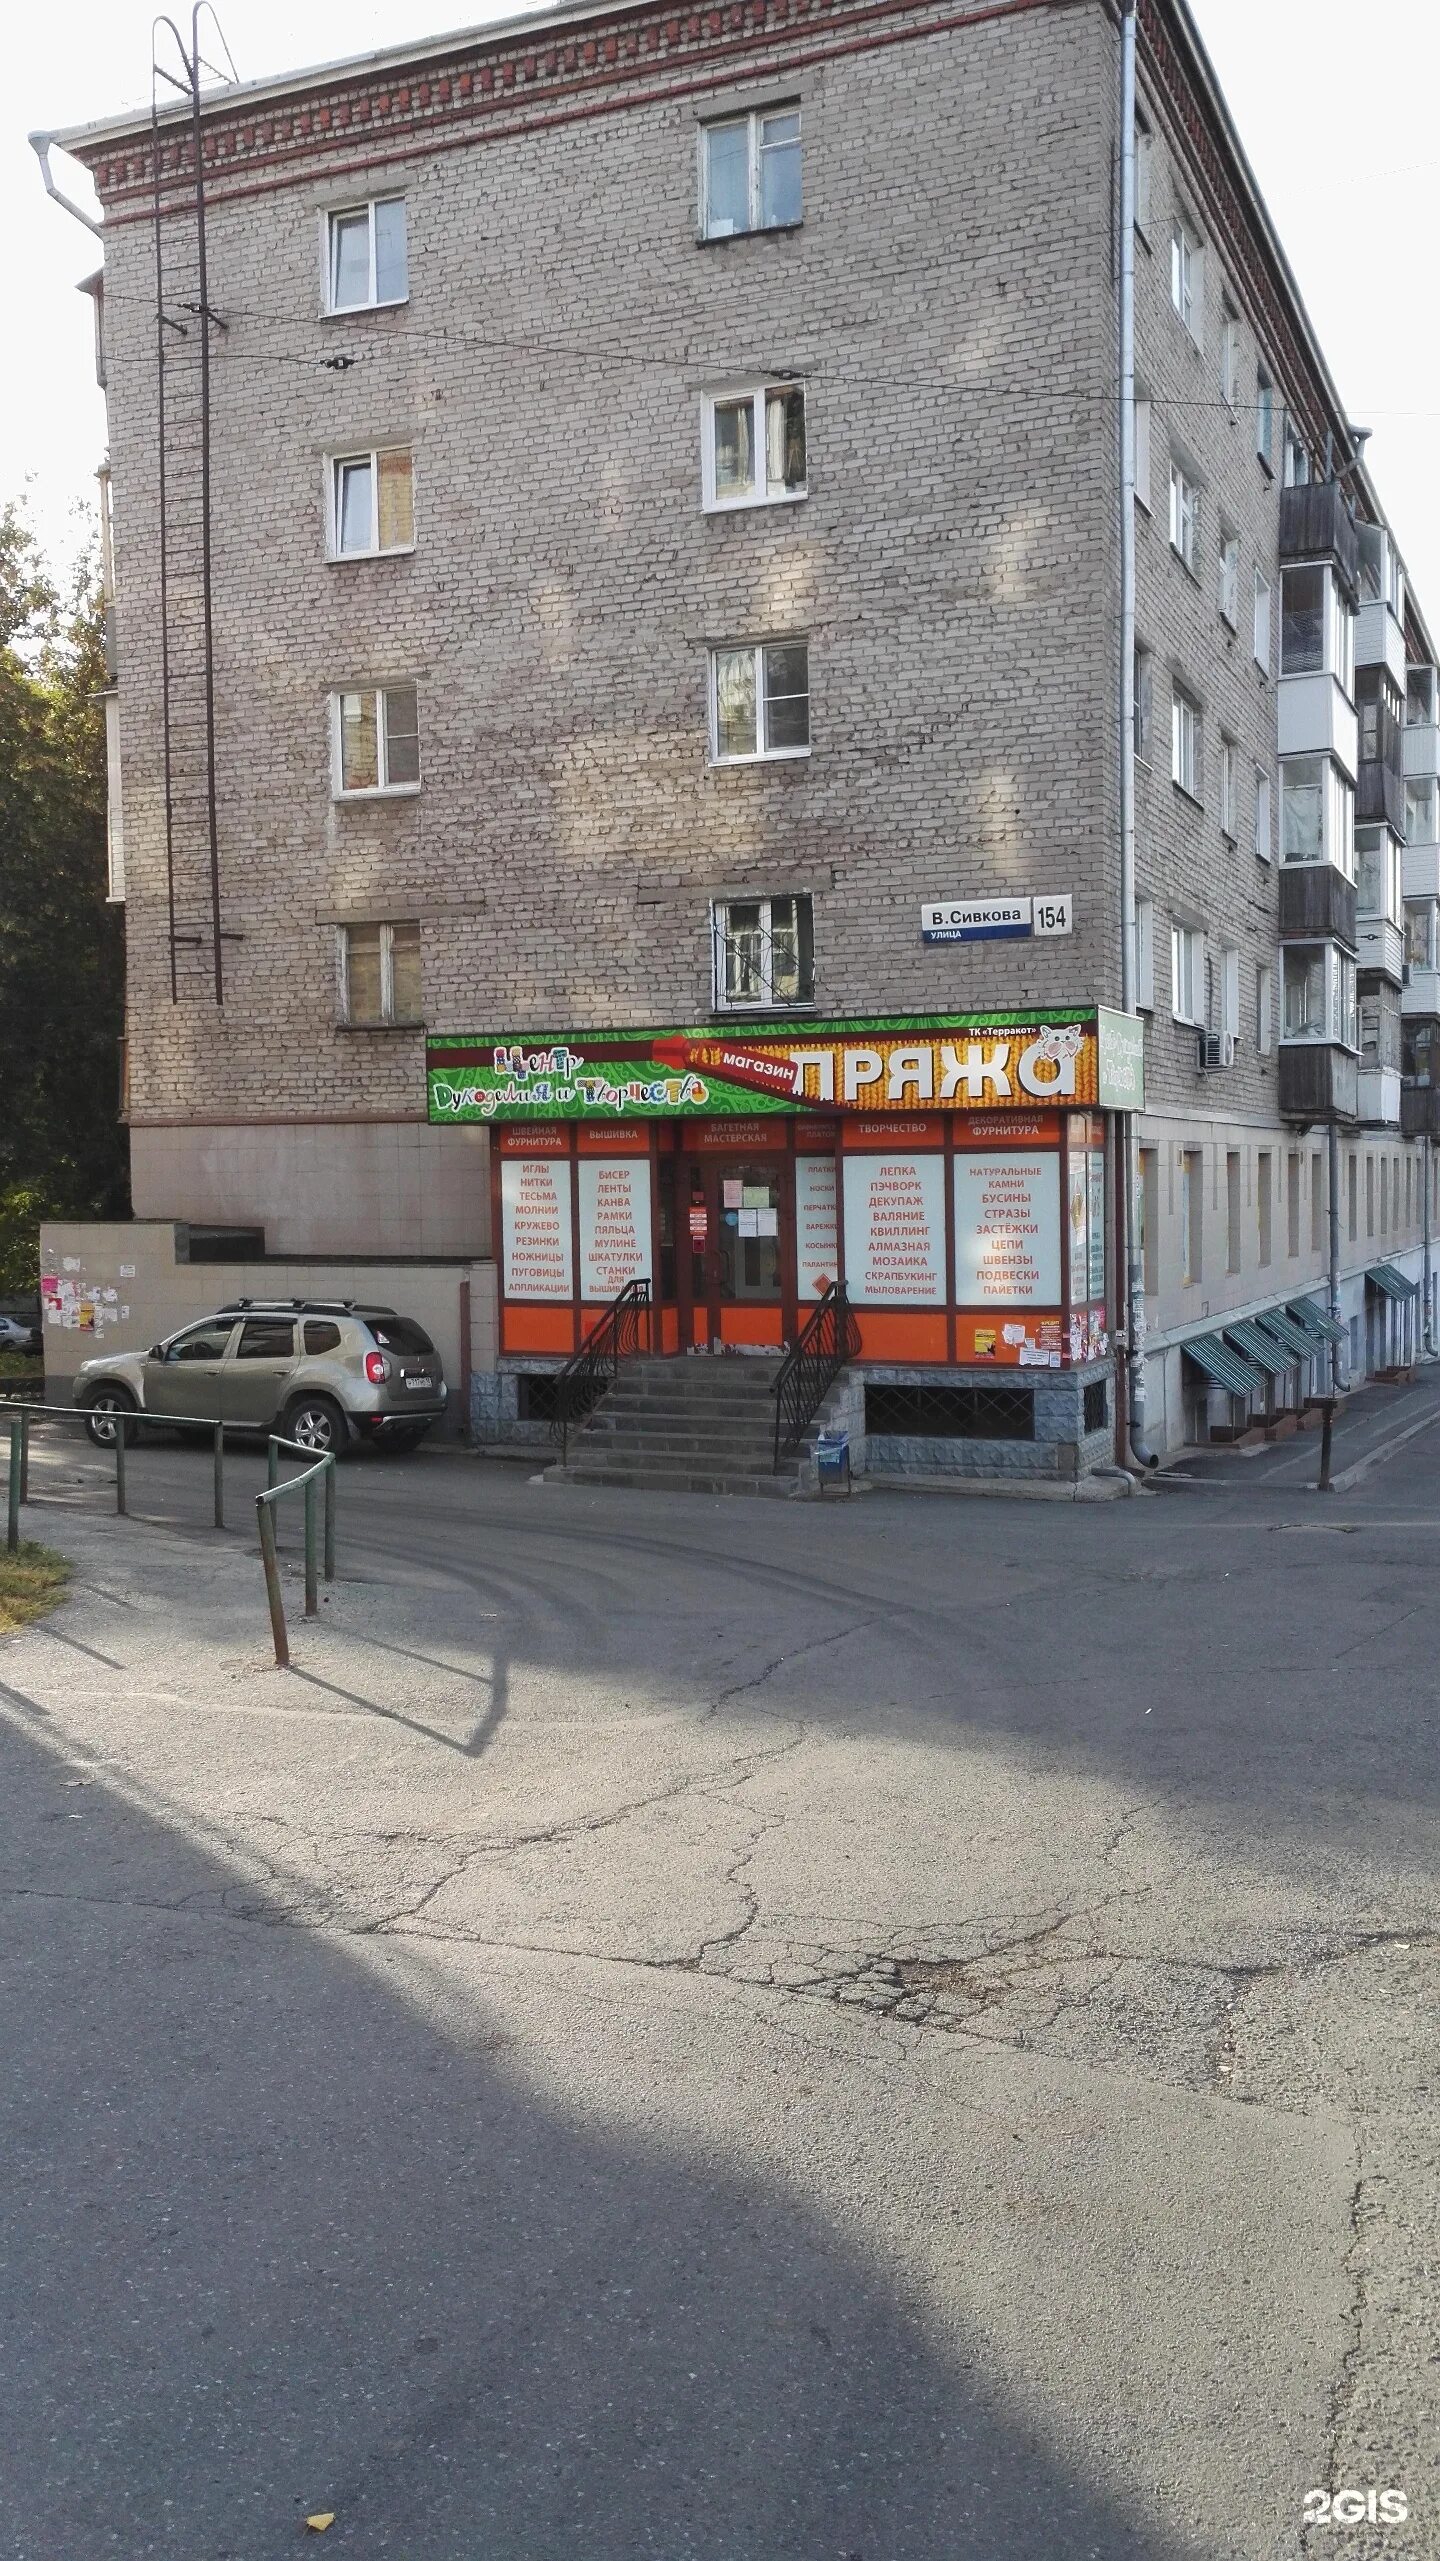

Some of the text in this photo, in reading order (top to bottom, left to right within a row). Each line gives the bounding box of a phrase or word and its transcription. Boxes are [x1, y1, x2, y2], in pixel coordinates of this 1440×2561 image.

[932, 909, 1021, 925] В.Сивкова
[1037, 905, 1066, 929] 154
[969, 1027, 1037, 1036] ТК «Терракот»
[723, 1052, 794, 1080] магазин
[433, 1074, 709, 1116] Рукоделия и Творчества
[968, 1115, 1043, 1126] ДЕКОРАТИВНАЯ
[512, 1126, 557, 1136] ШВЕЙНАЯ
[711, 1123, 760, 1132] БАГЕТНАЯ
[859, 1123, 927, 1133] ТВОРЧЕСТВО
[973, 1125, 1039, 1136] ФУРНИТУРА
[589, 1130, 638, 1139] ВЫШИВКА
[704, 1133, 767, 1143] МАСТЕРСКАЯ
[508, 1137, 562, 1147] ФУРНИТУРА
[522, 1164, 550, 1174] ИГЛЫ
[879, 1166, 917, 1176] ЛЕПКА
[969, 1167, 1042, 1177] НАТУРАЛЬНЫЕ
[598, 1170, 630, 1180] БИСЕР
[520, 1178, 553, 1187] НИТКИ
[870, 1181, 922, 1191] ПЭЧВОРК
[988, 1179, 1025, 1189] КАМНИ
[597, 1184, 632, 1194] ЛЕНТЫ
[519, 1191, 557, 1201] ТЕСЬМА
[981, 1193, 1032, 1204] БУСИНЫ
[597, 1198, 631, 1207] КАНВА
[868, 1196, 924, 1208] ДЕКУПАЖ
[515, 1206, 559, 1215] МОЛНИИ
[984, 1208, 1031, 1219] СТРАЗЫ
[597, 1211, 632, 1221] РАМКИ
[873, 1211, 925, 1222] ВАЛЯНИЕ
[514, 1221, 560, 1231] КРУЖЕВО
[594, 1225, 635, 1236] ПЯЛЬЦА
[976, 1222, 1039, 1235] ЗАСТЁЖКИ
[870, 1226, 931, 1237] КВИЛЛИНГ
[515, 1237, 560, 1246] РЕЗИНКИ
[594, 1239, 636, 1248] МУЛИНЕ
[868, 1241, 931, 1252] АЛМАЗНАЯ
[991, 1240, 1024, 1251] ЦЕПИ
[511, 1252, 564, 1263] НОЖНИЦЫ
[588, 1252, 643, 1262] ШКАТУЛКИ
[872, 1256, 928, 1266] МОЗАИКА
[983, 1255, 1033, 1265] ШВЕНЗЫ
[511, 1268, 565, 1278] ПУГОВИЦЫ
[596, 1266, 636, 1275] СТАНКИ
[608, 1276, 625, 1285] ДЛЯ
[864, 1271, 937, 1281] СКРАПБУКИНГ
[976, 1270, 1039, 1282] ПОДВЕСКИ
[508, 1283, 570, 1293] АППЛИКАЦИИ
[864, 1285, 937, 1295] МЫЛОВАРЕНИЕ
[983, 1283, 1033, 1295] ПАЙЕТКИ
